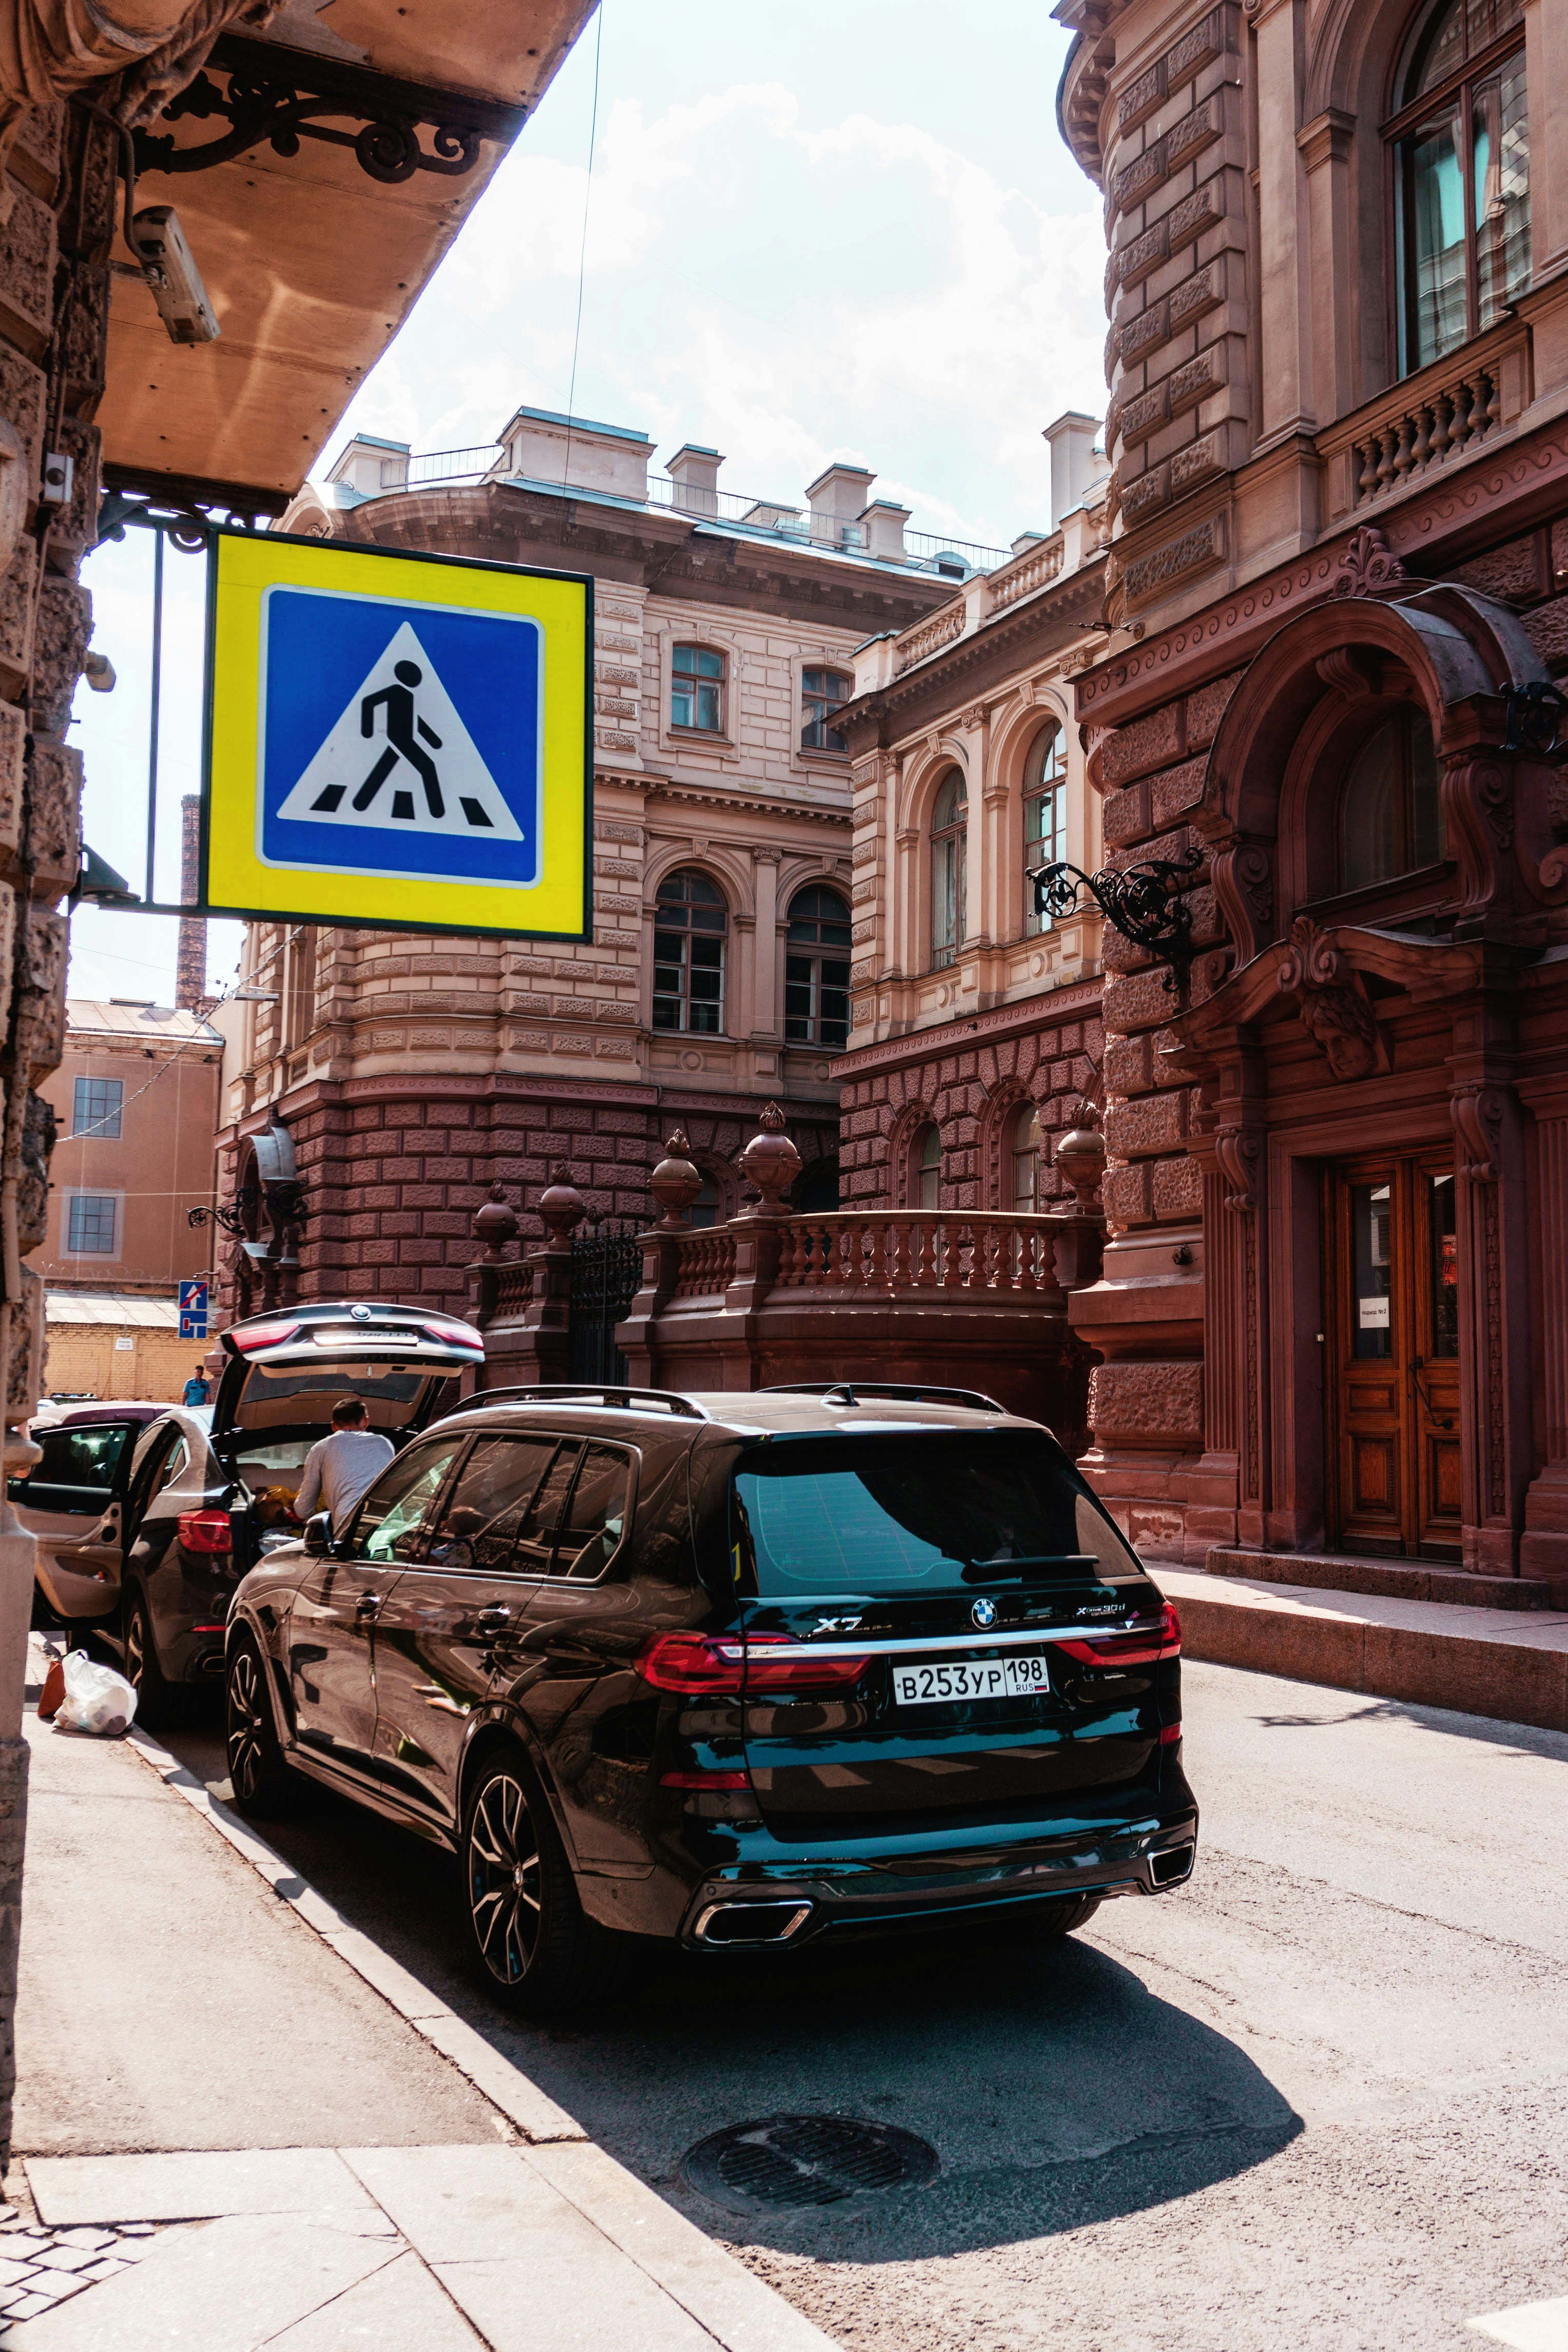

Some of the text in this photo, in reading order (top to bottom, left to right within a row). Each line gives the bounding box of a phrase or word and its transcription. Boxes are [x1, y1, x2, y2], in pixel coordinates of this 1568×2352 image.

[974, 1599, 994, 1610] BMW
[812, 1616, 862, 1632] X7
[1006, 1659, 1043, 1683] 198
[1016, 1683, 1034, 1692] RUS
